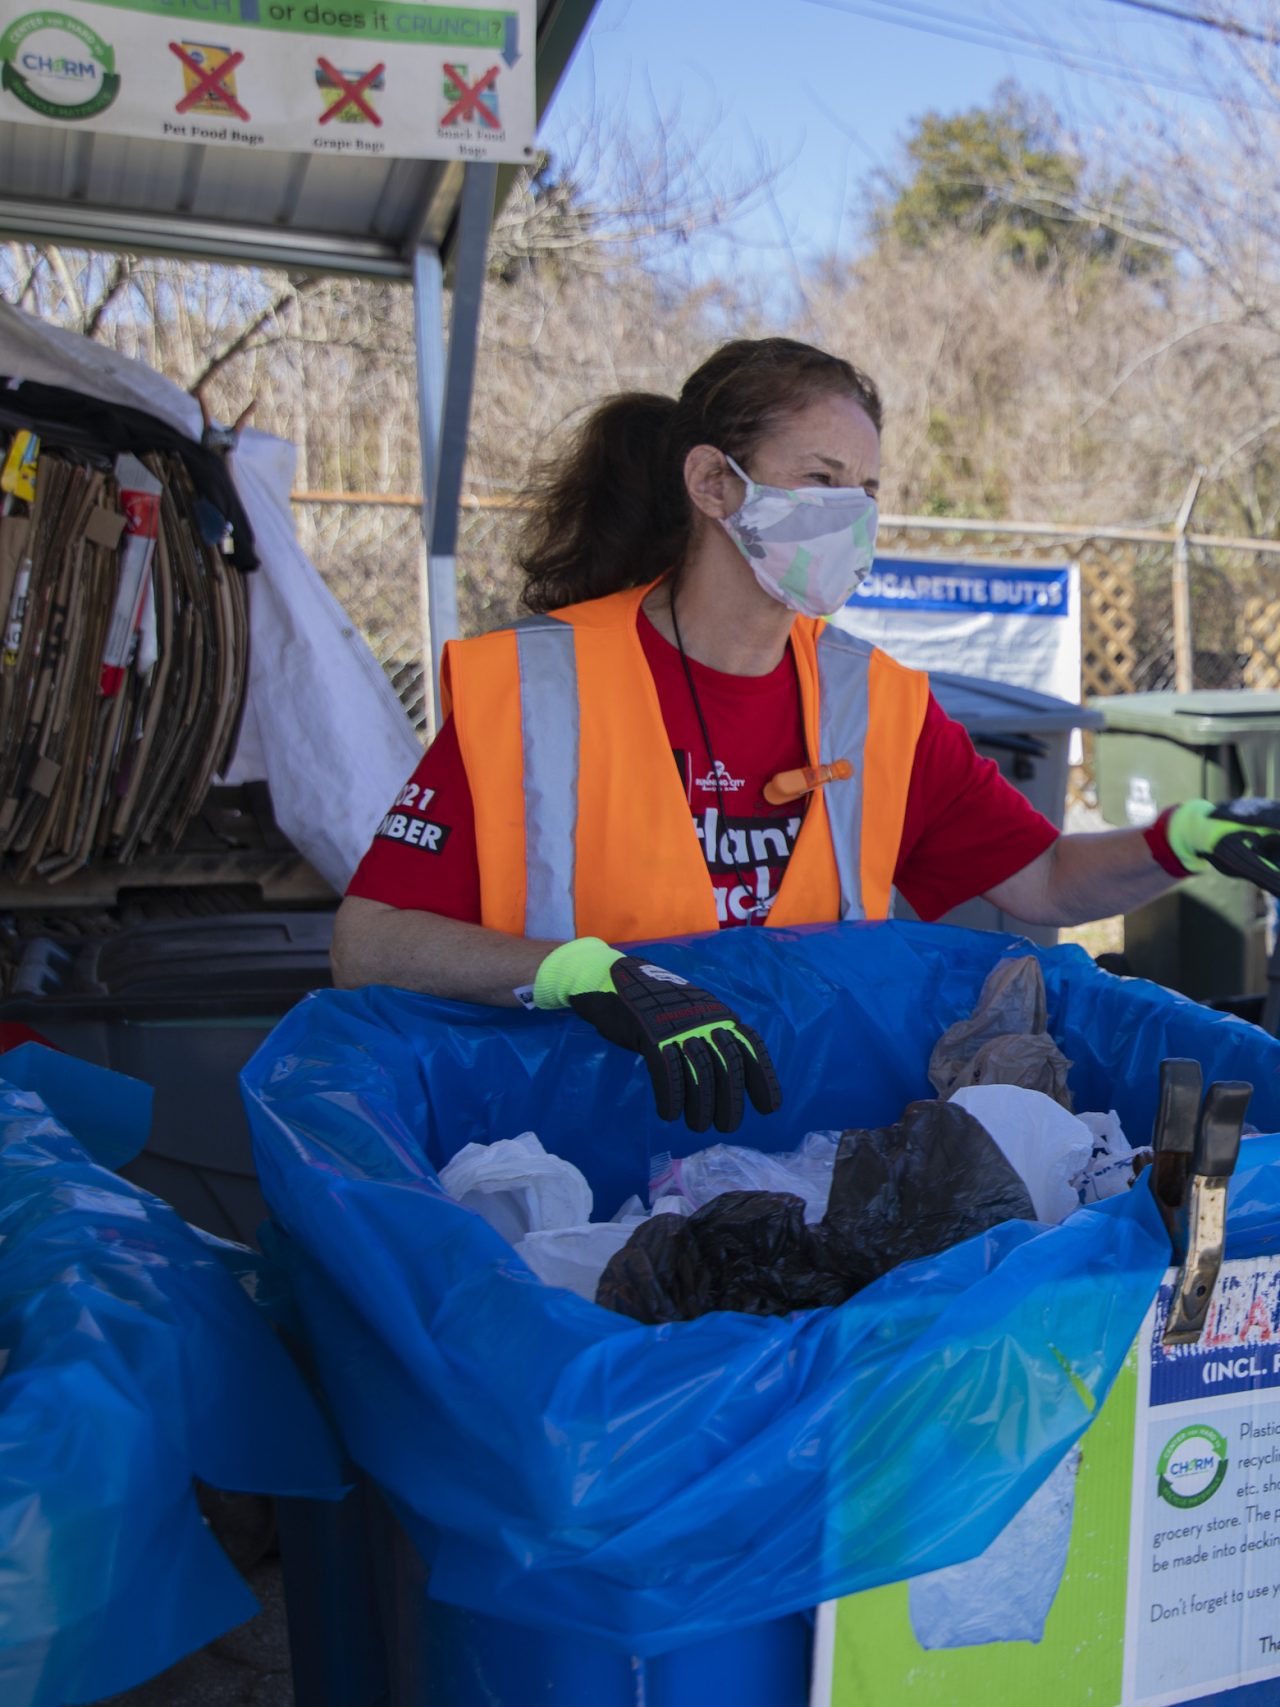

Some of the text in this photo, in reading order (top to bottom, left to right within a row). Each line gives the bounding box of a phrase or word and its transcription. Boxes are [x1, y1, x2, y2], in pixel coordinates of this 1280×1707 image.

[269, 4, 501, 40] or does it CRUNCH?
[162, 122, 265, 146] Pet Food Bags
[856, 573, 987, 603] CIGARETTE
[1202, 1356, 1268, 1384] (INCL.
[1237, 1485, 1260, 1498] etc.
[1152, 1524, 1204, 1549] grocery
[1207, 1517, 1242, 1532] store.
[1246, 1504, 1271, 1523] The
[1152, 1554, 1169, 1573] be
[1173, 1544, 1209, 1568] made
[1212, 1543, 1236, 1559] into
[1150, 1598, 1187, 1622] Don't
[1191, 1594, 1228, 1613] forget
[1231, 1589, 1244, 1603] to
[1248, 1585, 1269, 1599] use
